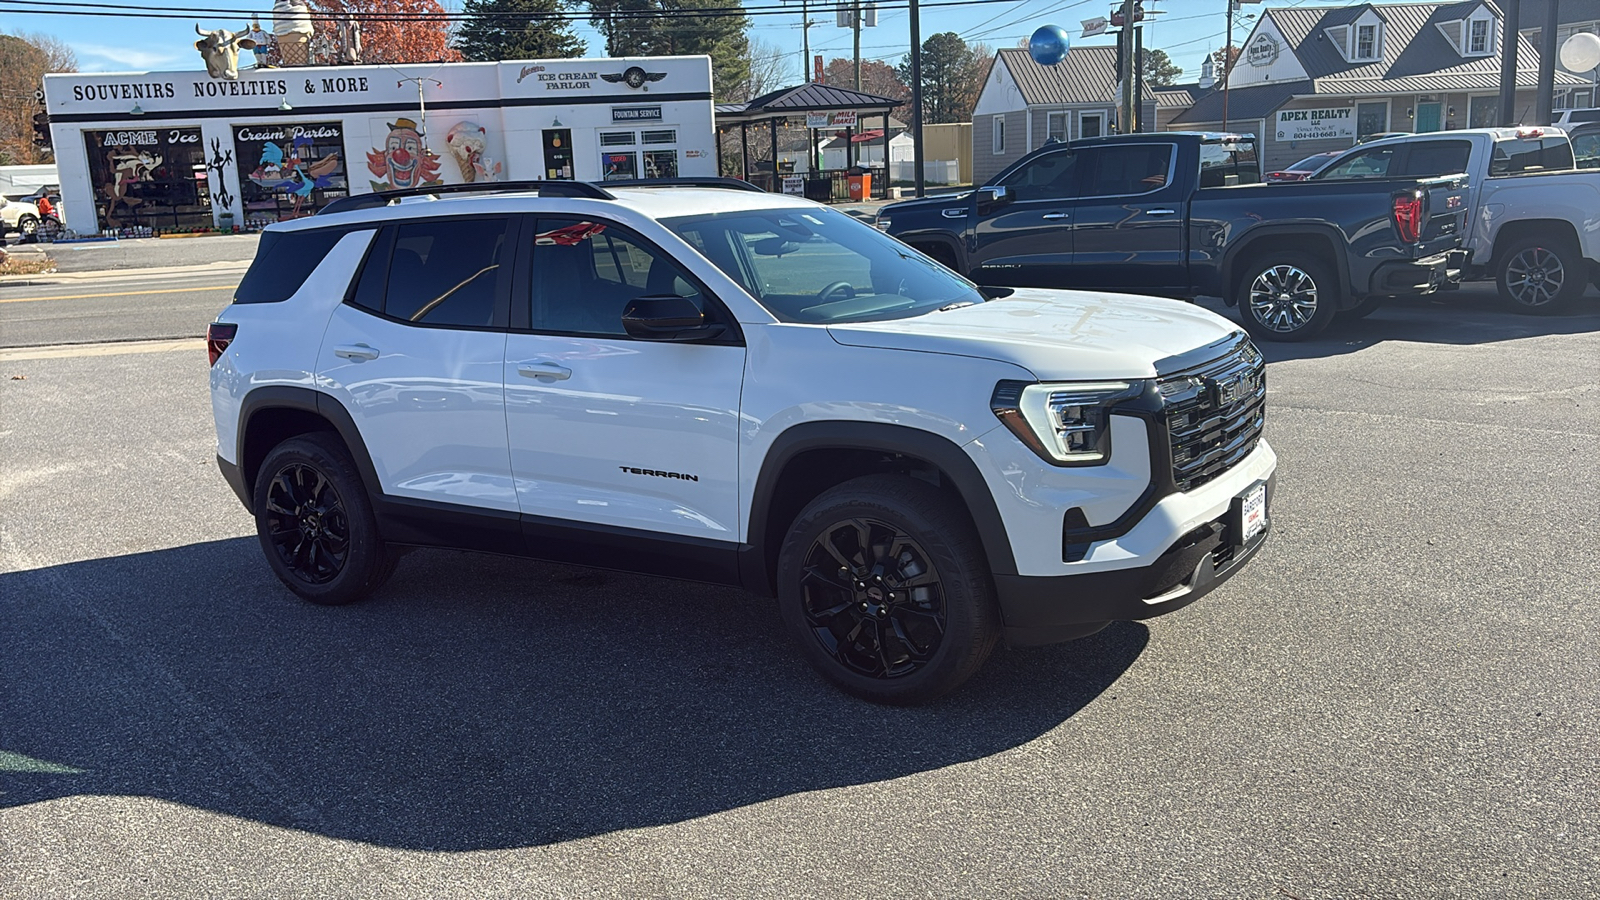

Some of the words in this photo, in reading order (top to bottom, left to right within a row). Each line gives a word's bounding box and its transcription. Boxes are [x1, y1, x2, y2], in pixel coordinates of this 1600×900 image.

[538, 73, 556, 81] ICE
[558, 72, 597, 81] CREAM
[73, 82, 175, 101] SOUVENIRS
[193, 79, 288, 98] NOVELTIES
[304, 79, 316, 94] &
[322, 77, 369, 94] MORE
[546, 81, 591, 90] PARLOR
[614, 110, 639, 119] FOUNTAIN
[639, 109, 661, 118] SERVICE
[1281, 111, 1308, 121] APEX
[1311, 109, 1351, 120] REALTY
[104, 131, 158, 146] ACME
[168, 130, 199, 144] Ice
[238, 128, 285, 142] Cream
[292, 126, 341, 140] Parlor
[1294, 131, 1337, 139] 804-443-6683
[619, 466, 698, 482] TERRAIN
